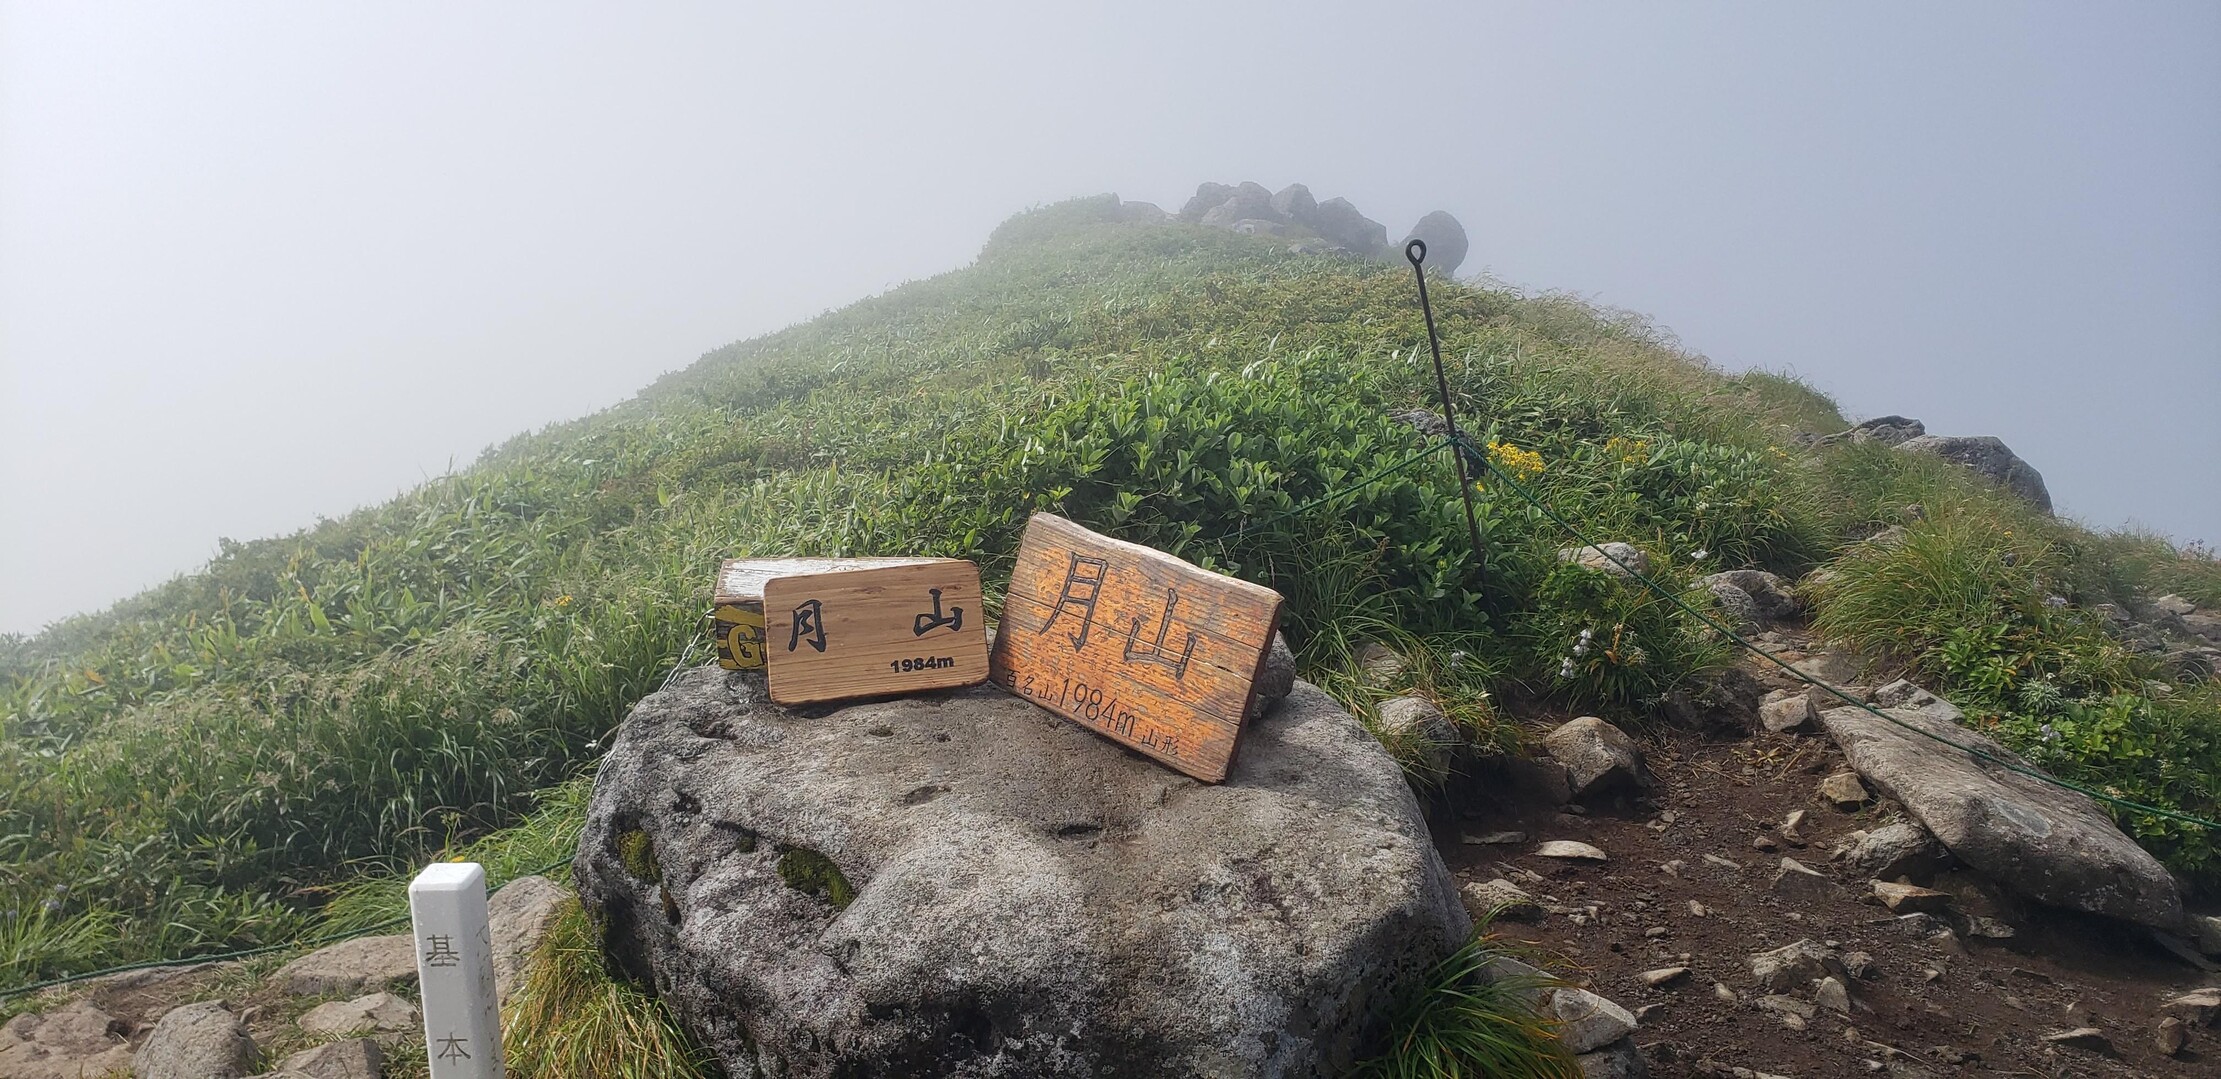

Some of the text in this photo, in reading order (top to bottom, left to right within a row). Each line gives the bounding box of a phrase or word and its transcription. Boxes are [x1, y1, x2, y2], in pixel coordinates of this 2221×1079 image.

[1039, 551, 1197, 680] 月山
[727, 624, 765, 668] G
[890, 655, 955, 674] 1984m
[1058, 678, 1136, 738] 1984m
[425, 933, 472, 1067] 基本
